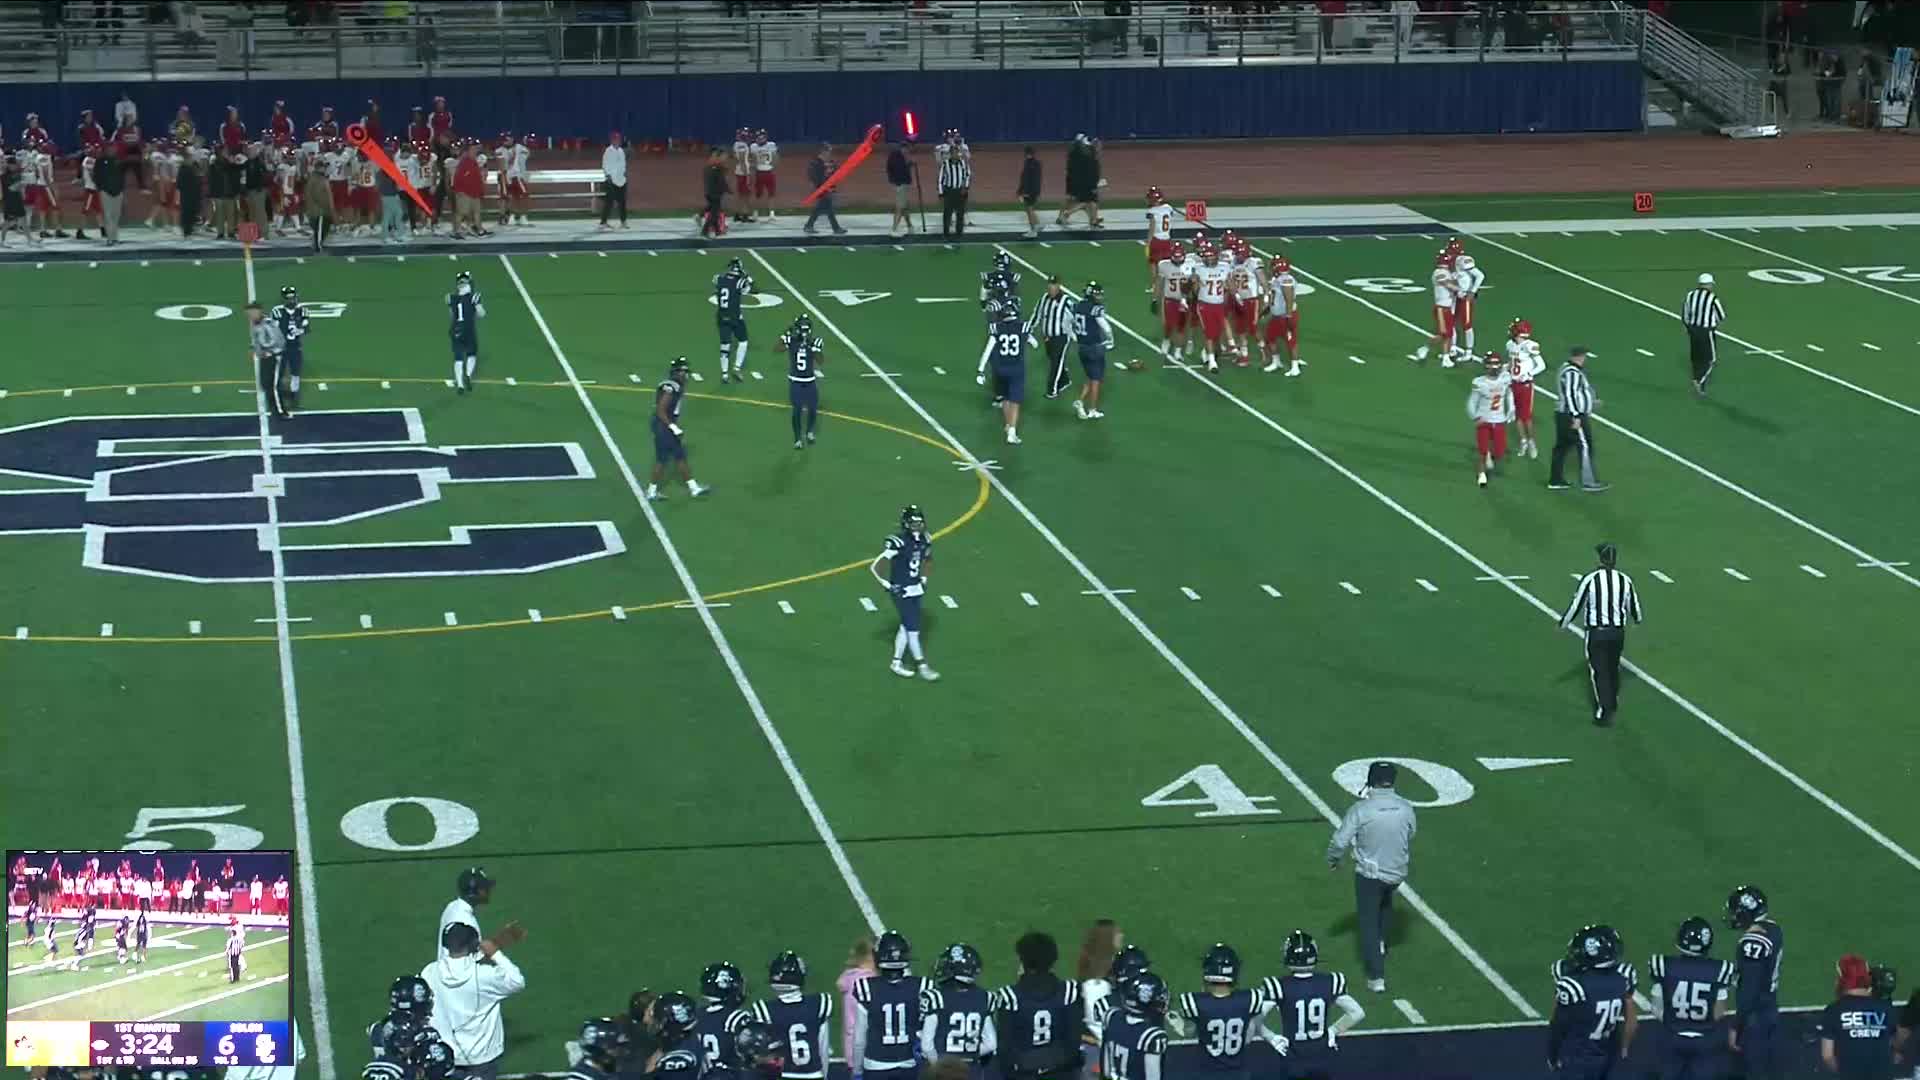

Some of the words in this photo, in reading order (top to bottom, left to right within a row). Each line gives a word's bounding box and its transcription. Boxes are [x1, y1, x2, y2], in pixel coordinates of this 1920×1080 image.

[1188, 203, 1204, 217] 30
[1638, 194, 1651, 209] 20
[719, 287, 730, 309] 2
[1205, 280, 1224, 296] 72
[455, 302, 466, 323] 1
[999, 334, 1020, 356] 33
[796, 351, 807, 372] 5
[908, 558, 921, 578] 9
[1743, 942, 1763, 960] 47
[1671, 980, 1712, 1021] 45
[881, 1002, 909, 1044] 11
[1033, 1009, 1052, 1046] 8
[1294, 998, 1326, 1042] 19
[1840, 1011, 1886, 1027] SETV
[946, 1011, 982, 1053] 29
[1206, 1017, 1244, 1058] 38
[1849, 1029, 1881, 1038] CREW
[788, 1023, 811, 1066] 6
